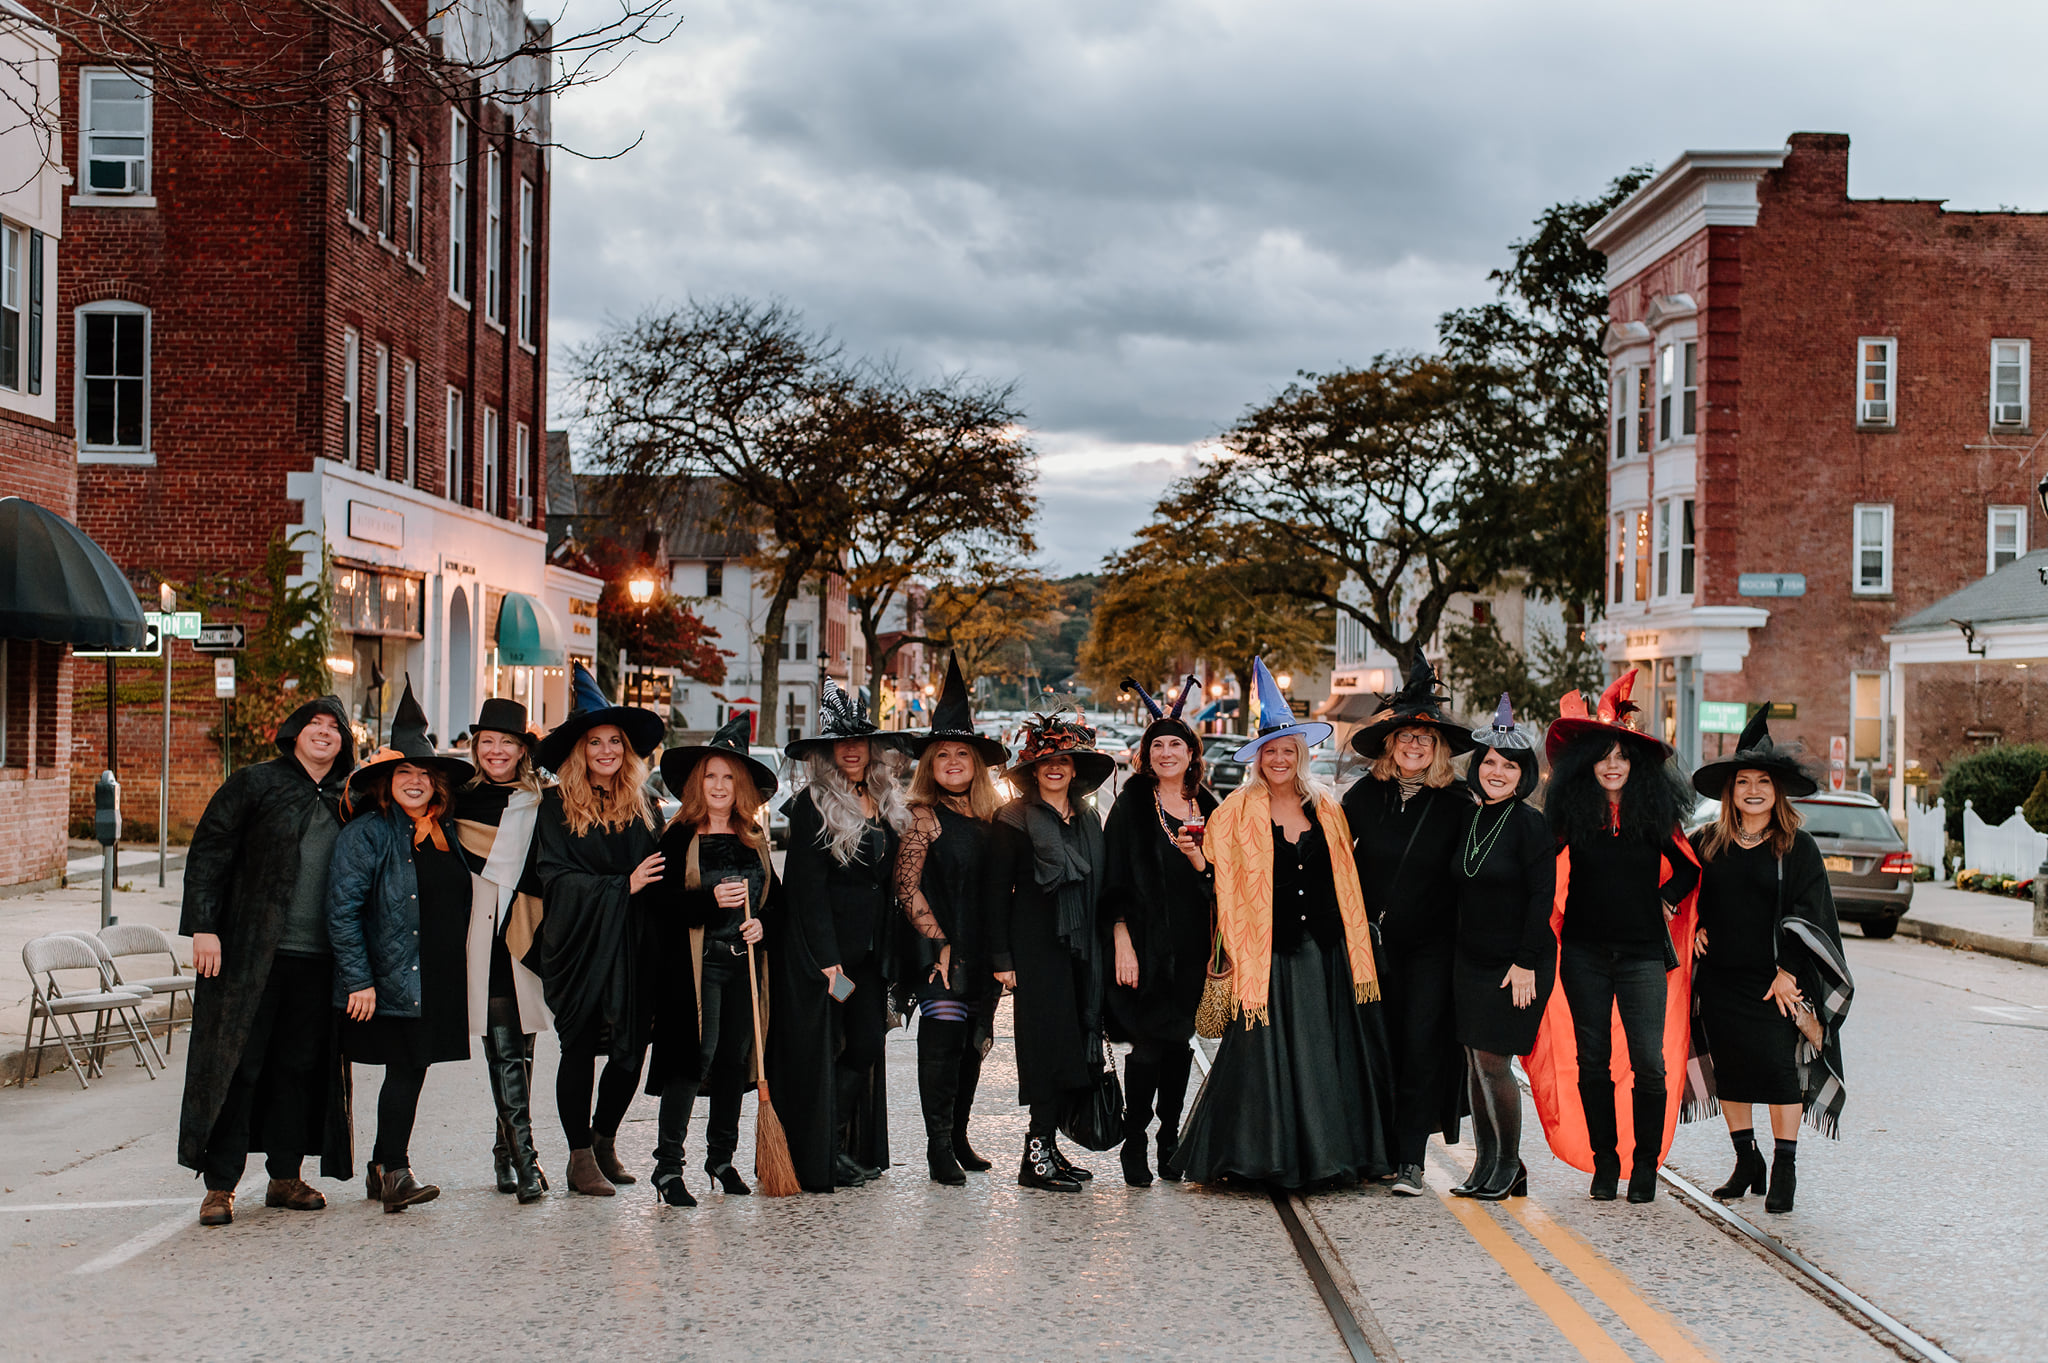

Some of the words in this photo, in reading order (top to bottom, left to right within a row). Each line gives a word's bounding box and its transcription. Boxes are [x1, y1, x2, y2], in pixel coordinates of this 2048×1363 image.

[184, 617, 195, 629] PL
[200, 631, 216, 641] ONE
[219, 631, 233, 641] WAY
